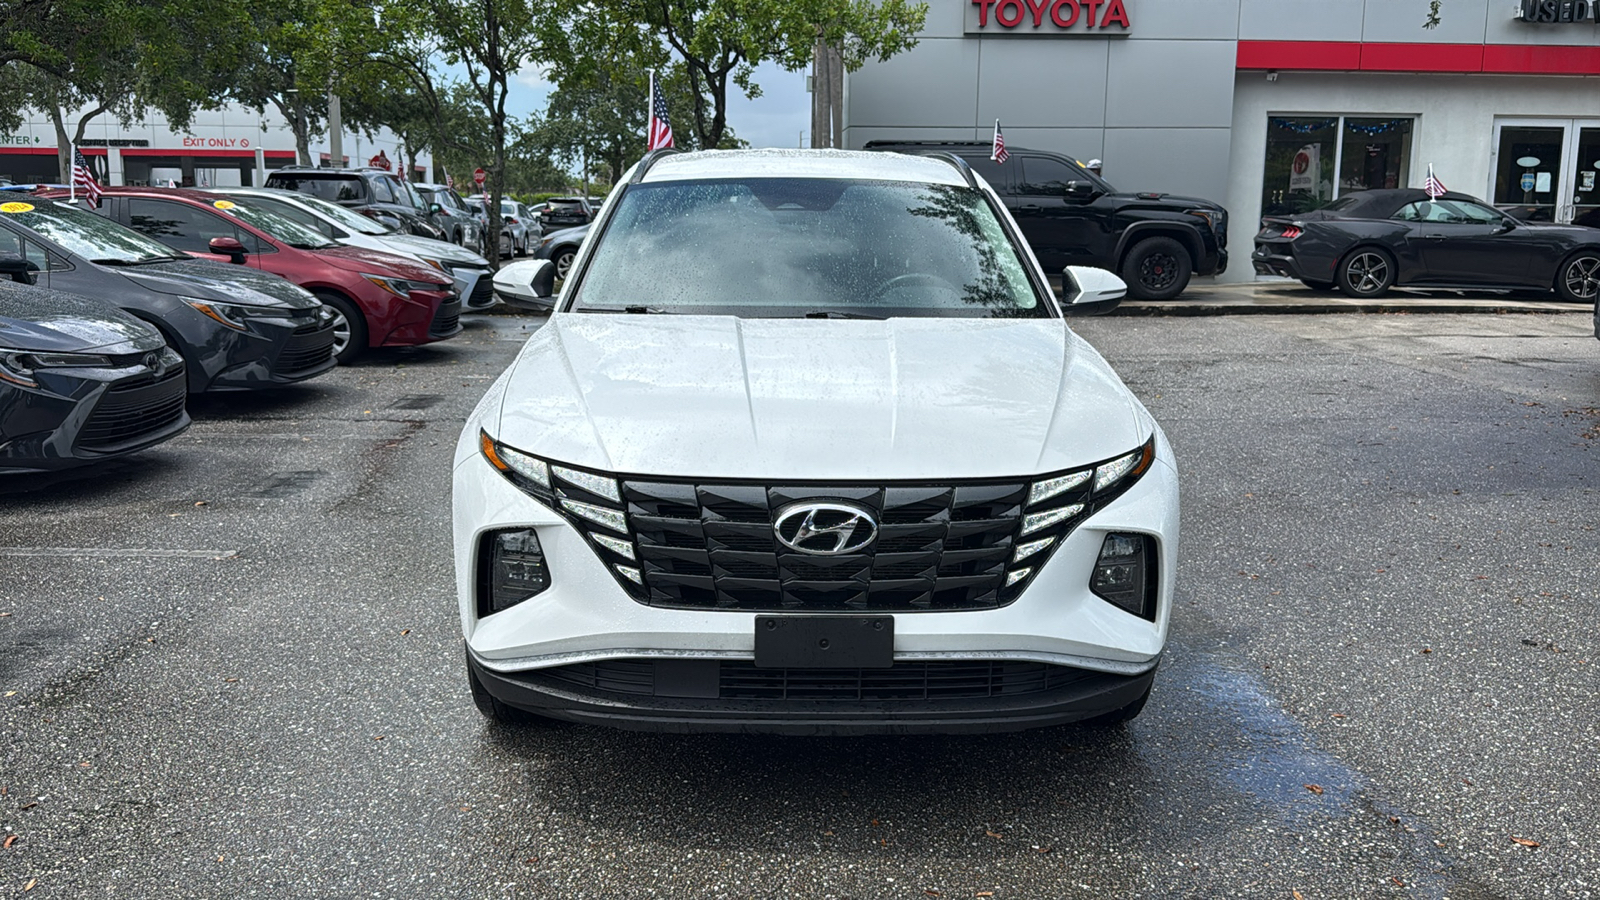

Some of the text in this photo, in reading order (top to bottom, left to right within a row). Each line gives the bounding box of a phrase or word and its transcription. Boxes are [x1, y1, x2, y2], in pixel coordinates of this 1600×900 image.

[971, 0, 1130, 28] TOYOTA
[1521, 0, 1588, 23] USED
[183, 138, 236, 147] EXIT ONLY
